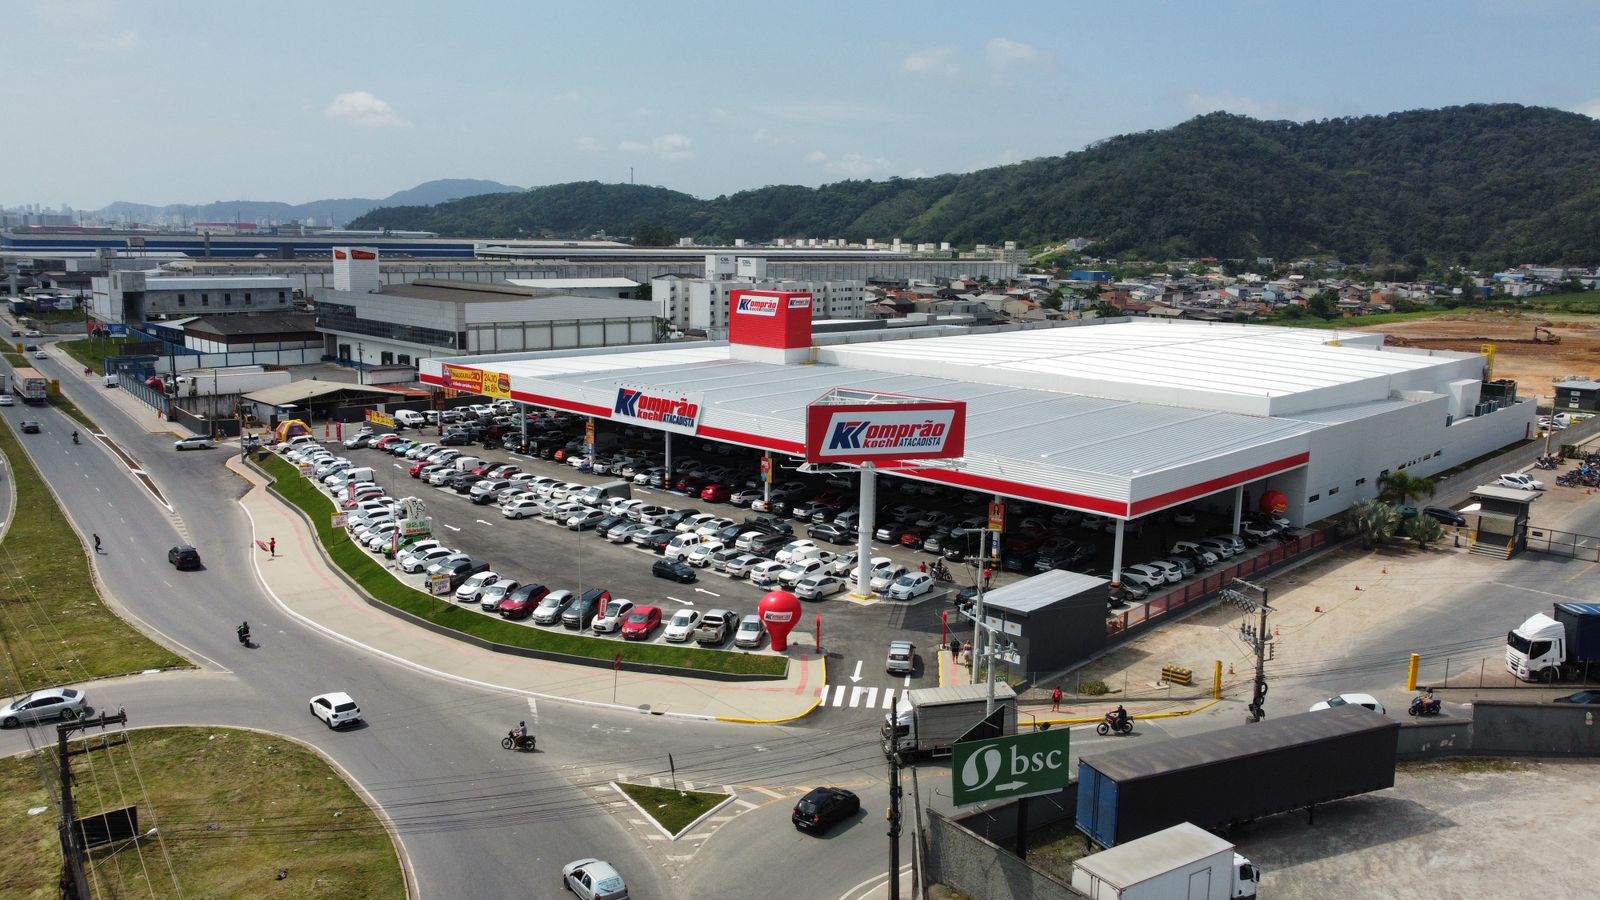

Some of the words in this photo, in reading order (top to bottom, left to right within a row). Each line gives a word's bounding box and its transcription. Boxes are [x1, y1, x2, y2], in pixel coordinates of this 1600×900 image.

[615, 388, 698, 422] Komprão
[637, 408, 659, 421] koch
[663, 413, 695, 428] ATACADISTA
[829, 420, 946, 449] Komprão
[862, 438, 894, 449] koch
[899, 437, 941, 448] ATACADISTA
[1009, 744, 1062, 776] bsc
